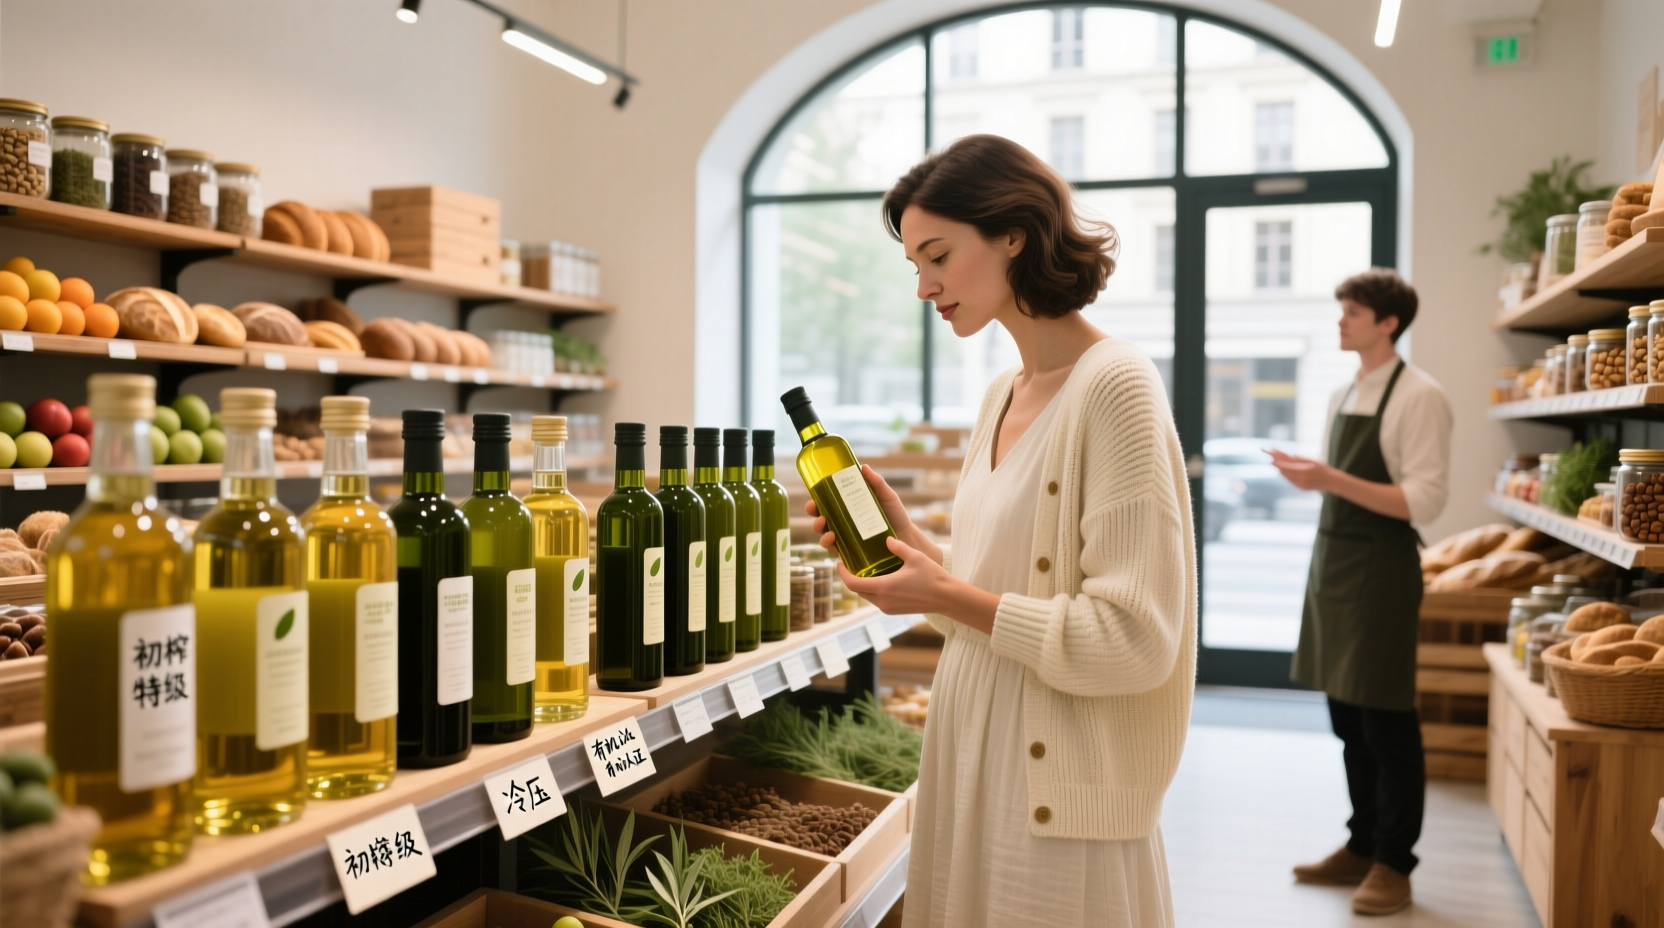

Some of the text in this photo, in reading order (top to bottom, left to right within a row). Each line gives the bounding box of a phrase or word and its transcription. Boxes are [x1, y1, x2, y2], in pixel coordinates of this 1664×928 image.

[133, 634, 189, 669] 初榨
[133, 672, 189, 709] 特级
[502, 776, 552, 815] 冷压
